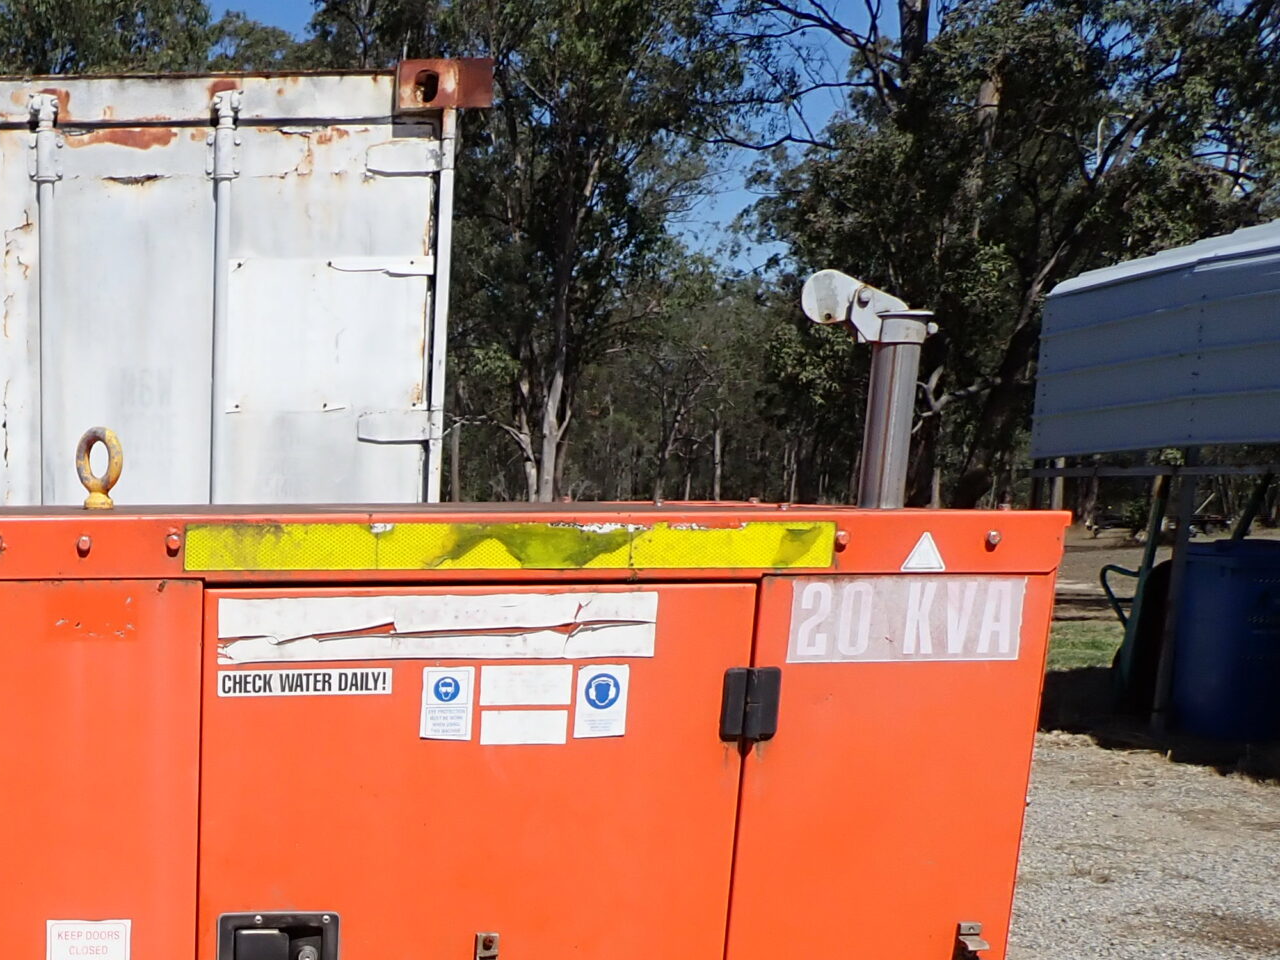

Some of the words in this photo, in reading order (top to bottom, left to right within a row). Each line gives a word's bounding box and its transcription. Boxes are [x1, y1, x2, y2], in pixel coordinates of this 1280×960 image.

[796, 581, 874, 656] 20
[902, 581, 1014, 655] KVA
[221, 673, 273, 694] CHECK
[279, 672, 332, 693] WATER
[338, 671, 387, 692] DAILY!
[57, 931, 83, 940] KEEP
[85, 930, 120, 940] DOORS
[68, 945, 109, 955] CLOSED
